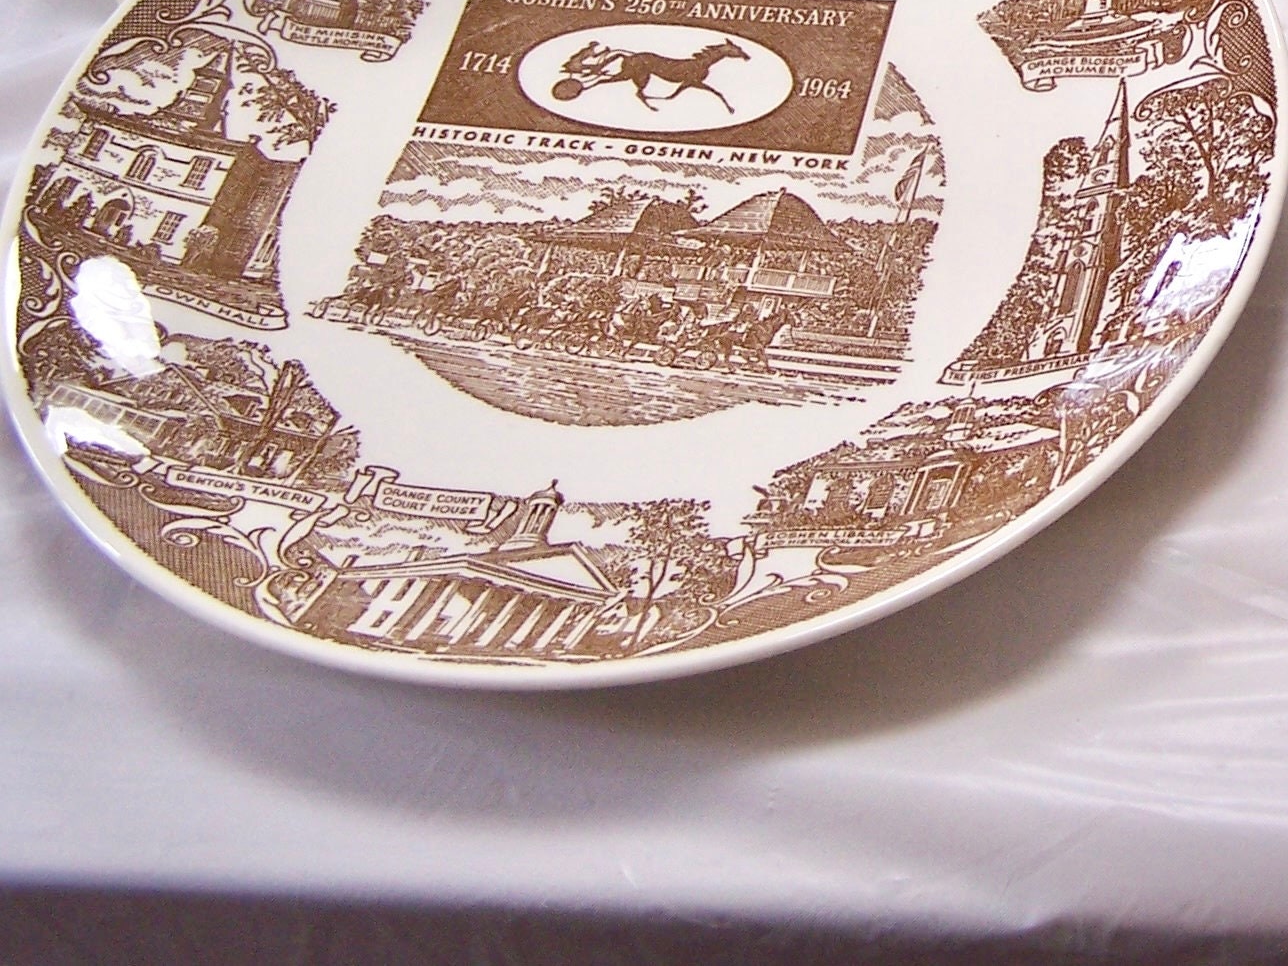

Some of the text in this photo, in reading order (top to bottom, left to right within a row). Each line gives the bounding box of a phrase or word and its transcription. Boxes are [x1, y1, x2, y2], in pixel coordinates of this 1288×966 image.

[686, 1, 856, 29] ANNIVERSARY
[288, 23, 387, 44] THE MINISINK
[458, 51, 513, 75] 1714
[1026, 57, 1077, 71] ORANGE
[1039, 65, 1128, 76] MONUMENT
[797, 76, 853, 100] 1964
[411, 125, 527, 146] HISTORIC
[525, 135, 596, 153] TRACK
[731, 149, 780, 166] NEW
[792, 157, 851, 171] YORK
[218, 306, 270, 327] HALL
[969, 370, 998, 381] FIRST
[250, 484, 314, 506] TAVERN
[382, 487, 487, 505] ORANGE COUNTY
[382, 496, 480, 515] COURT HOUSE
